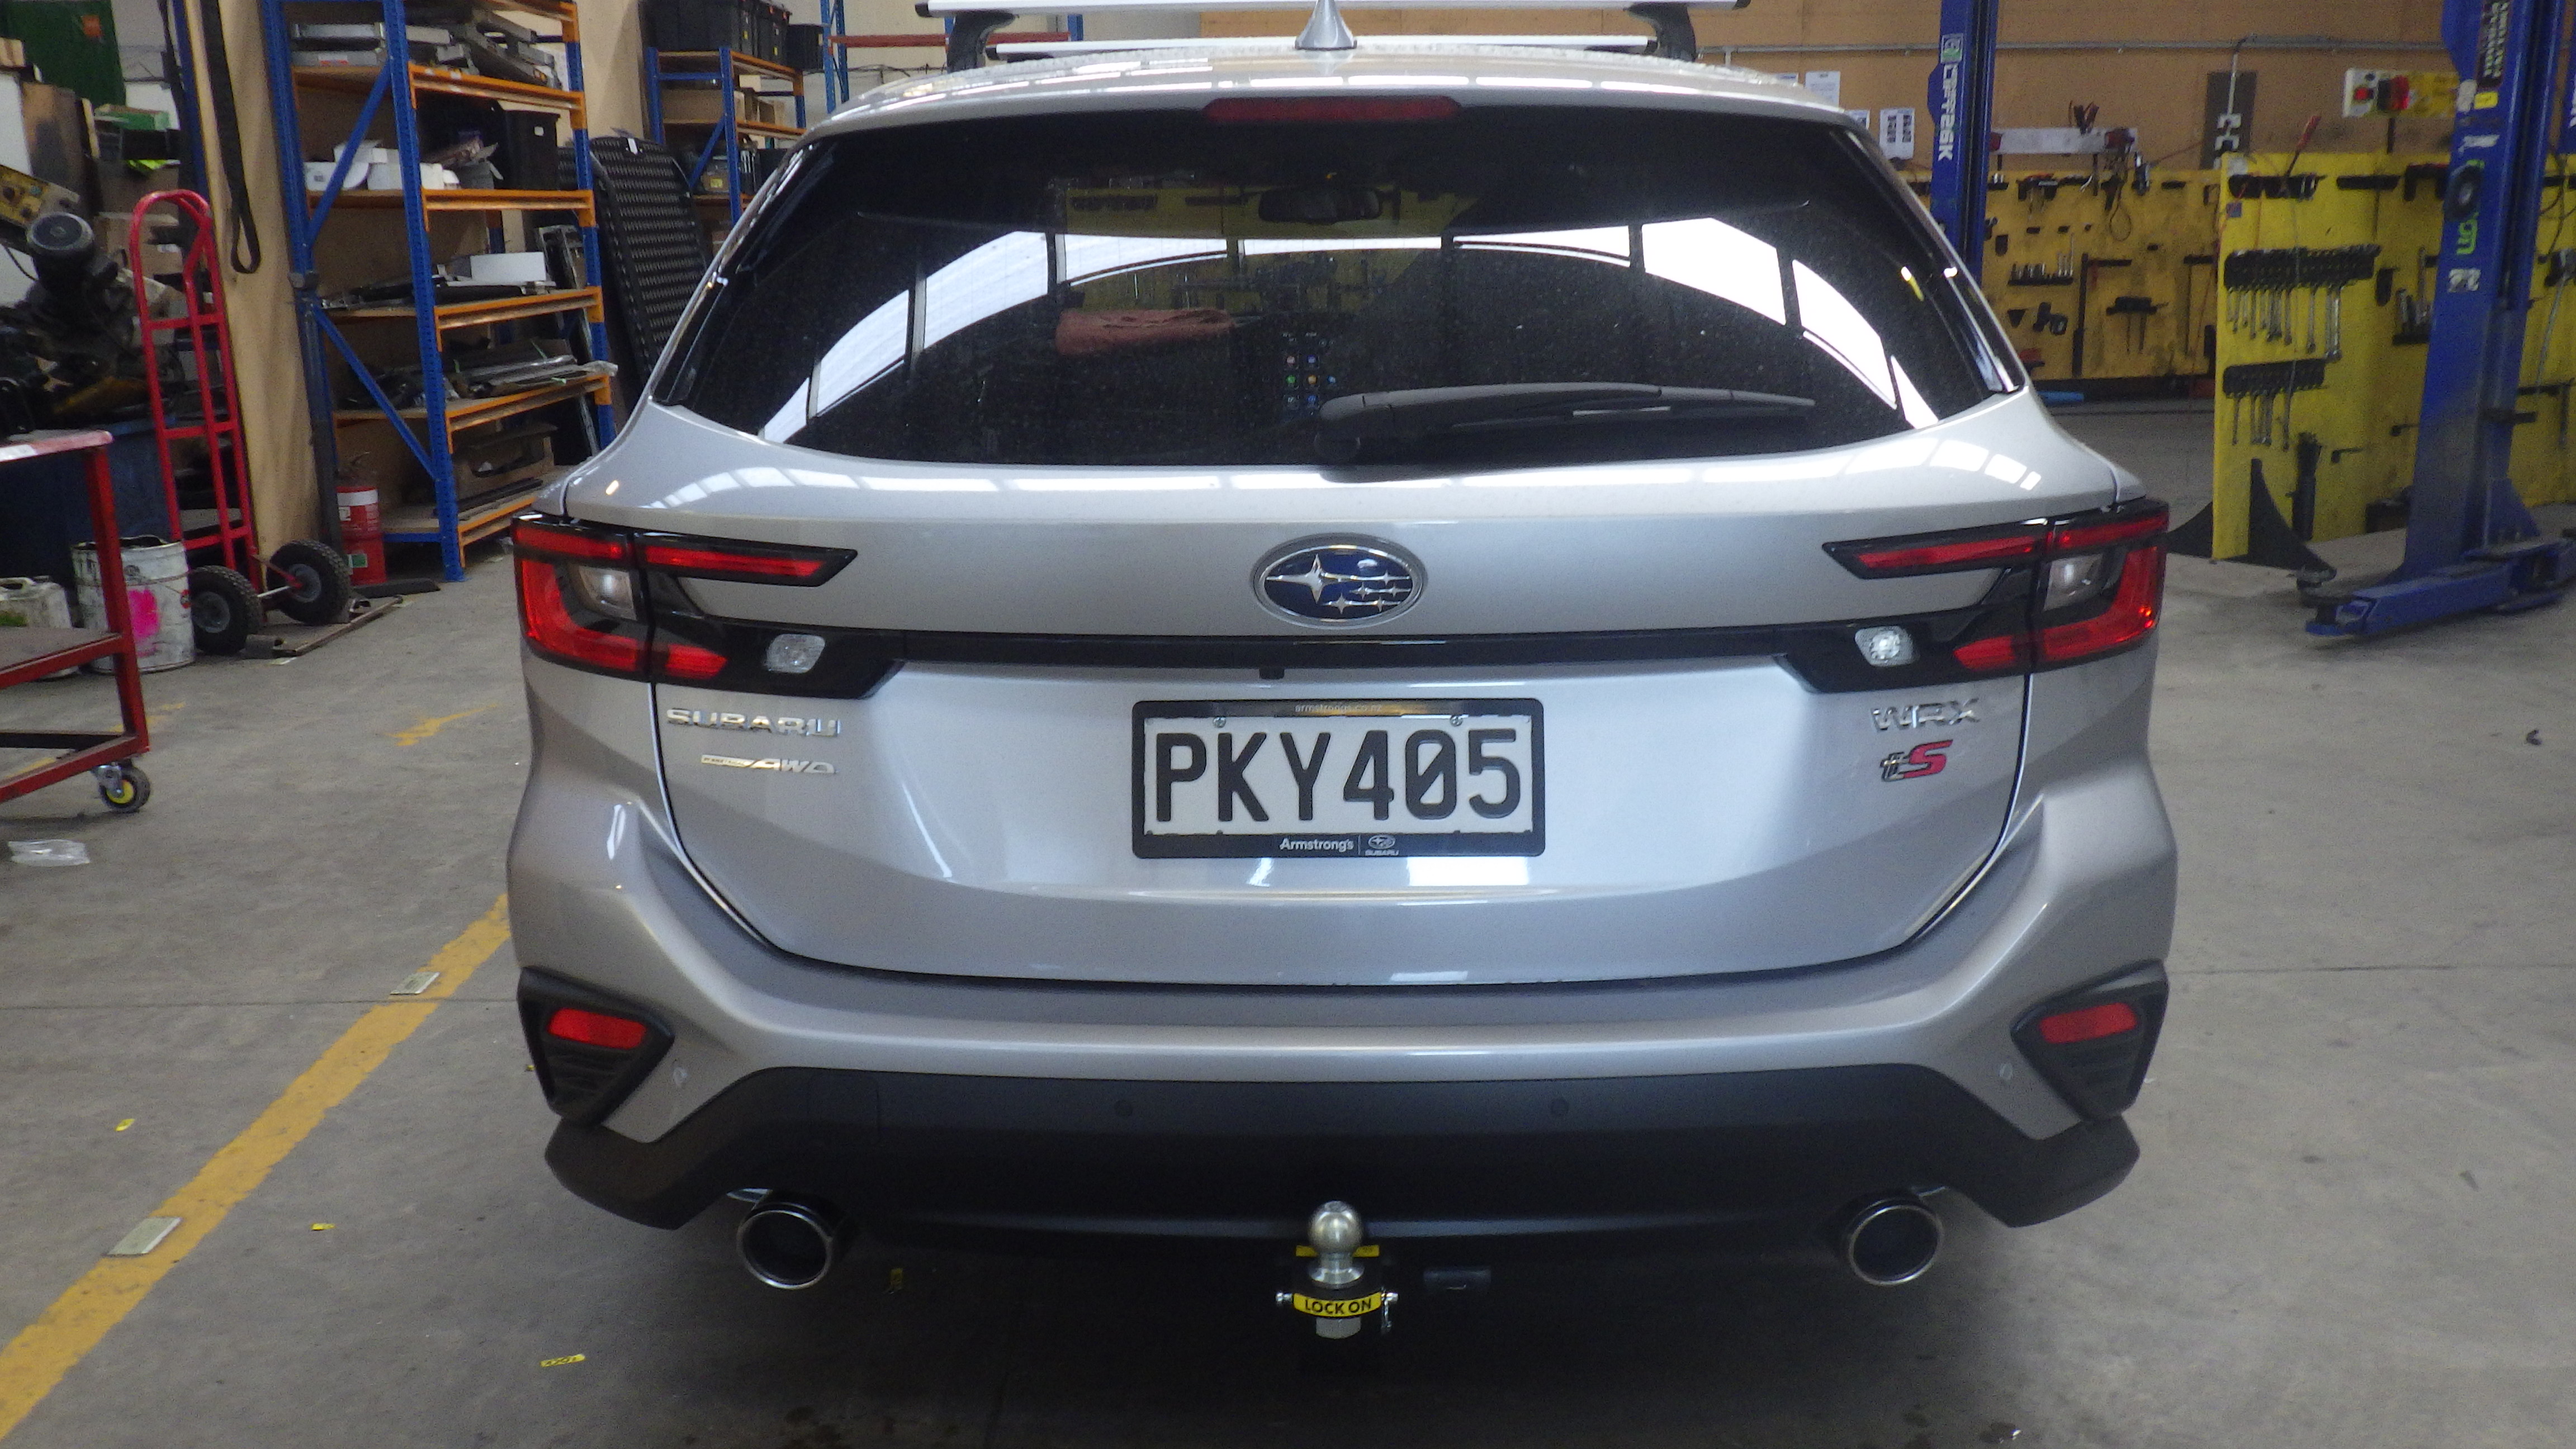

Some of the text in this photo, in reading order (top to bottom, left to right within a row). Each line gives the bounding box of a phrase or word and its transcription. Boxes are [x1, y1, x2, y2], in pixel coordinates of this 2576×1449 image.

[666, 707, 841, 737] SUBARU
[1871, 698, 1981, 732] WRX
[750, 757, 837, 774] AWD
[1155, 728, 1521, 822] PKY405
[1879, 739, 1953, 782] tS
[1280, 838, 1354, 852] Armstrong's
[1305, 1298, 1372, 1315] LOCK ON
